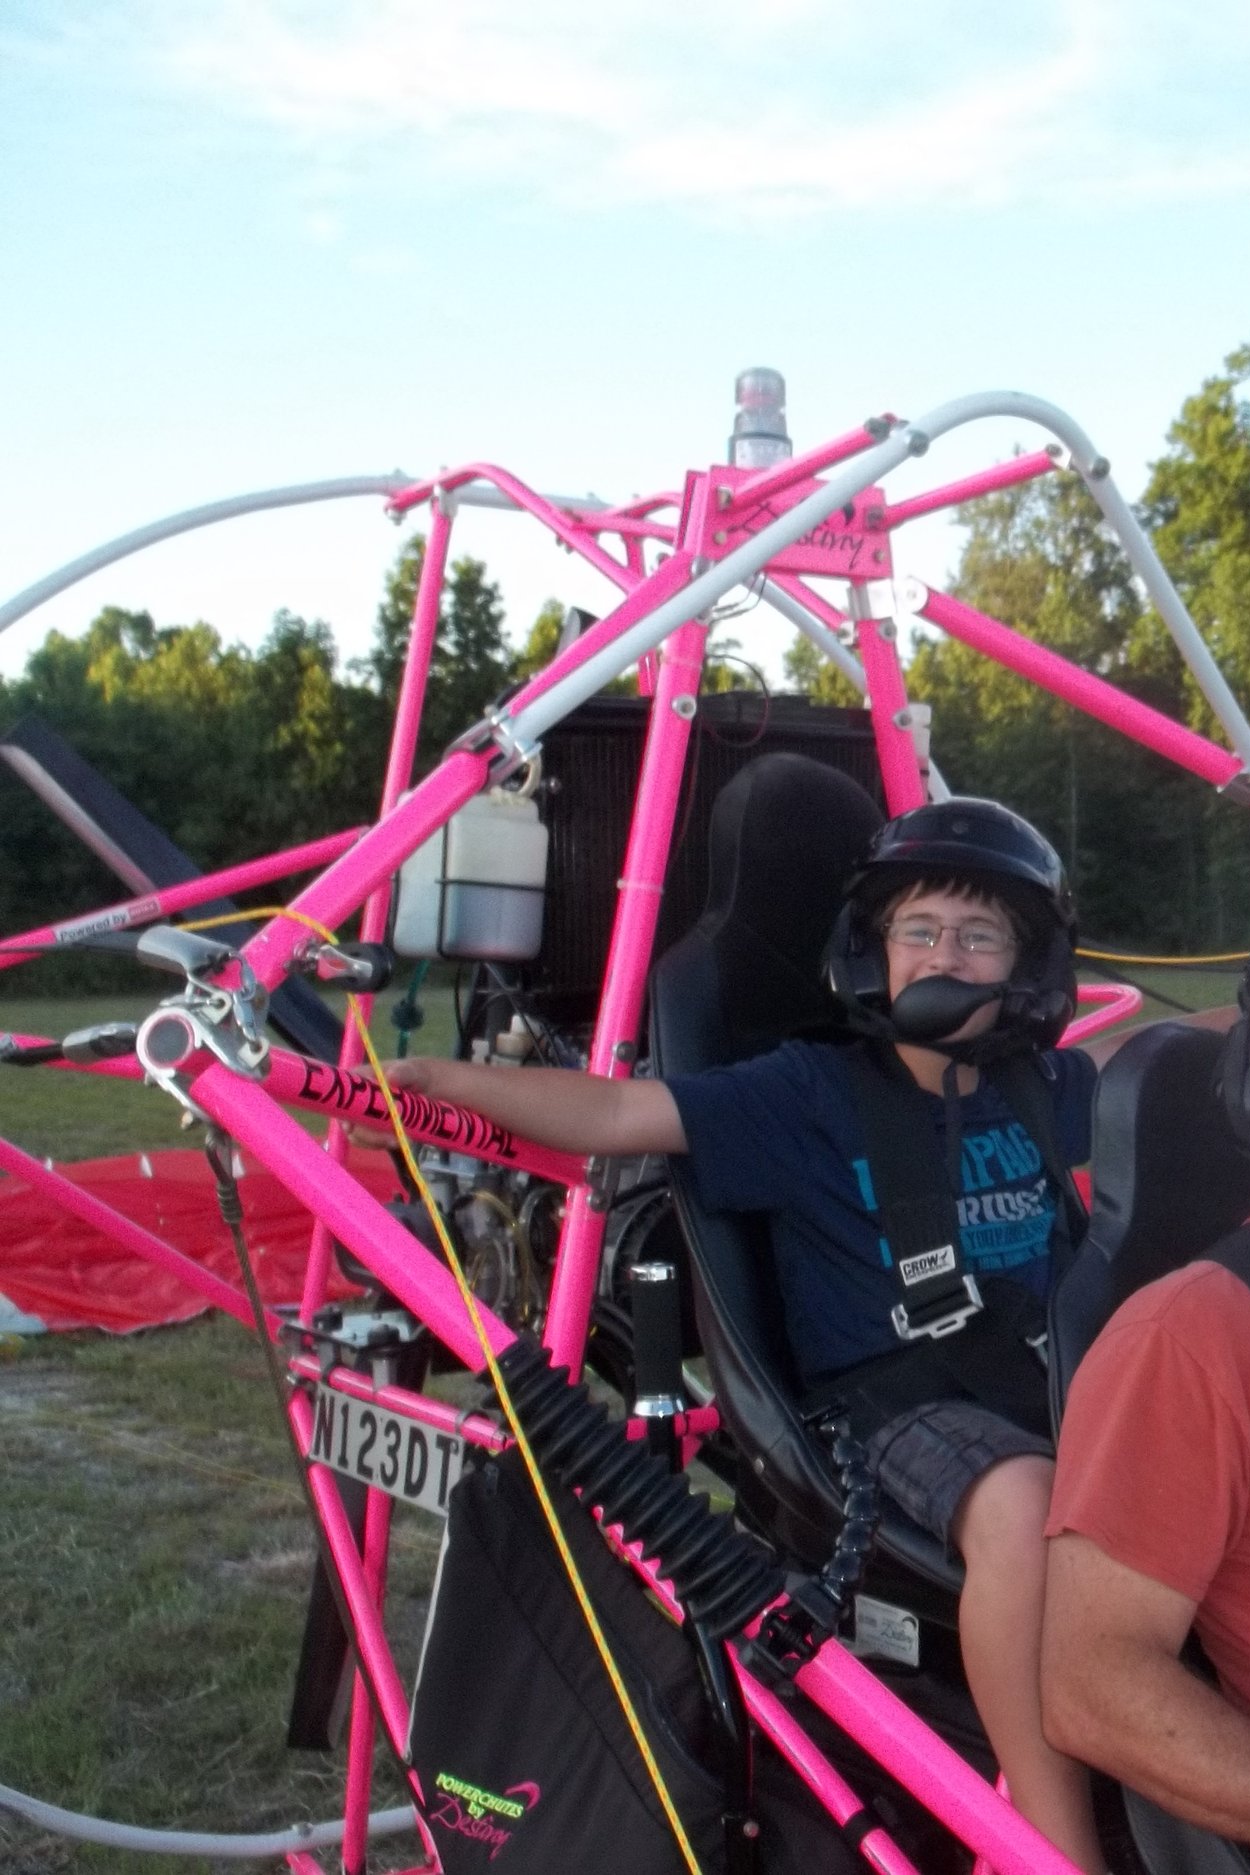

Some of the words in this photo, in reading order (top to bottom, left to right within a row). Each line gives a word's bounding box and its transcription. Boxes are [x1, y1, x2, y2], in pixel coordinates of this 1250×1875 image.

[60, 916, 110, 941] Powered
[111, 912, 127, 925] by
[903, 1253, 938, 1276] CROW
[313, 1392, 459, 1507] N123DT
[435, 1772, 524, 1818] POWERCHUTES
[467, 1803, 486, 1820] by
[430, 1792, 513, 1861] Destiny
